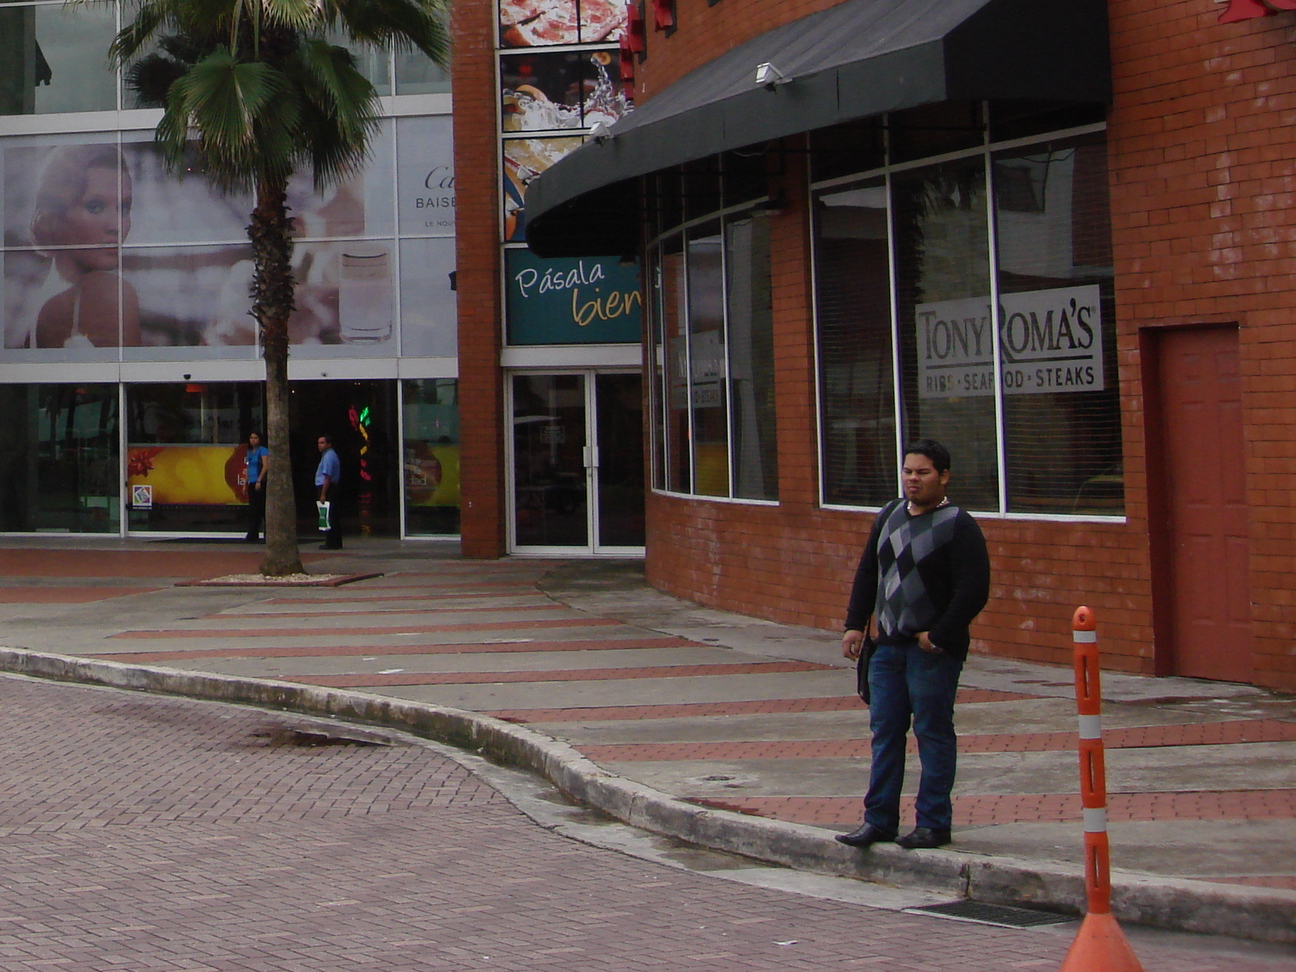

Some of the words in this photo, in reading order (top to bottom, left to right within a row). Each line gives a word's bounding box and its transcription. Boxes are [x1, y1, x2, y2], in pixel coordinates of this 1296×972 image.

[515, 260, 605, 298] Pásala
[918, 310, 988, 360] TONY
[964, 370, 1024, 391] SEAFOD
[1035, 366, 1095, 388] STEAKS
